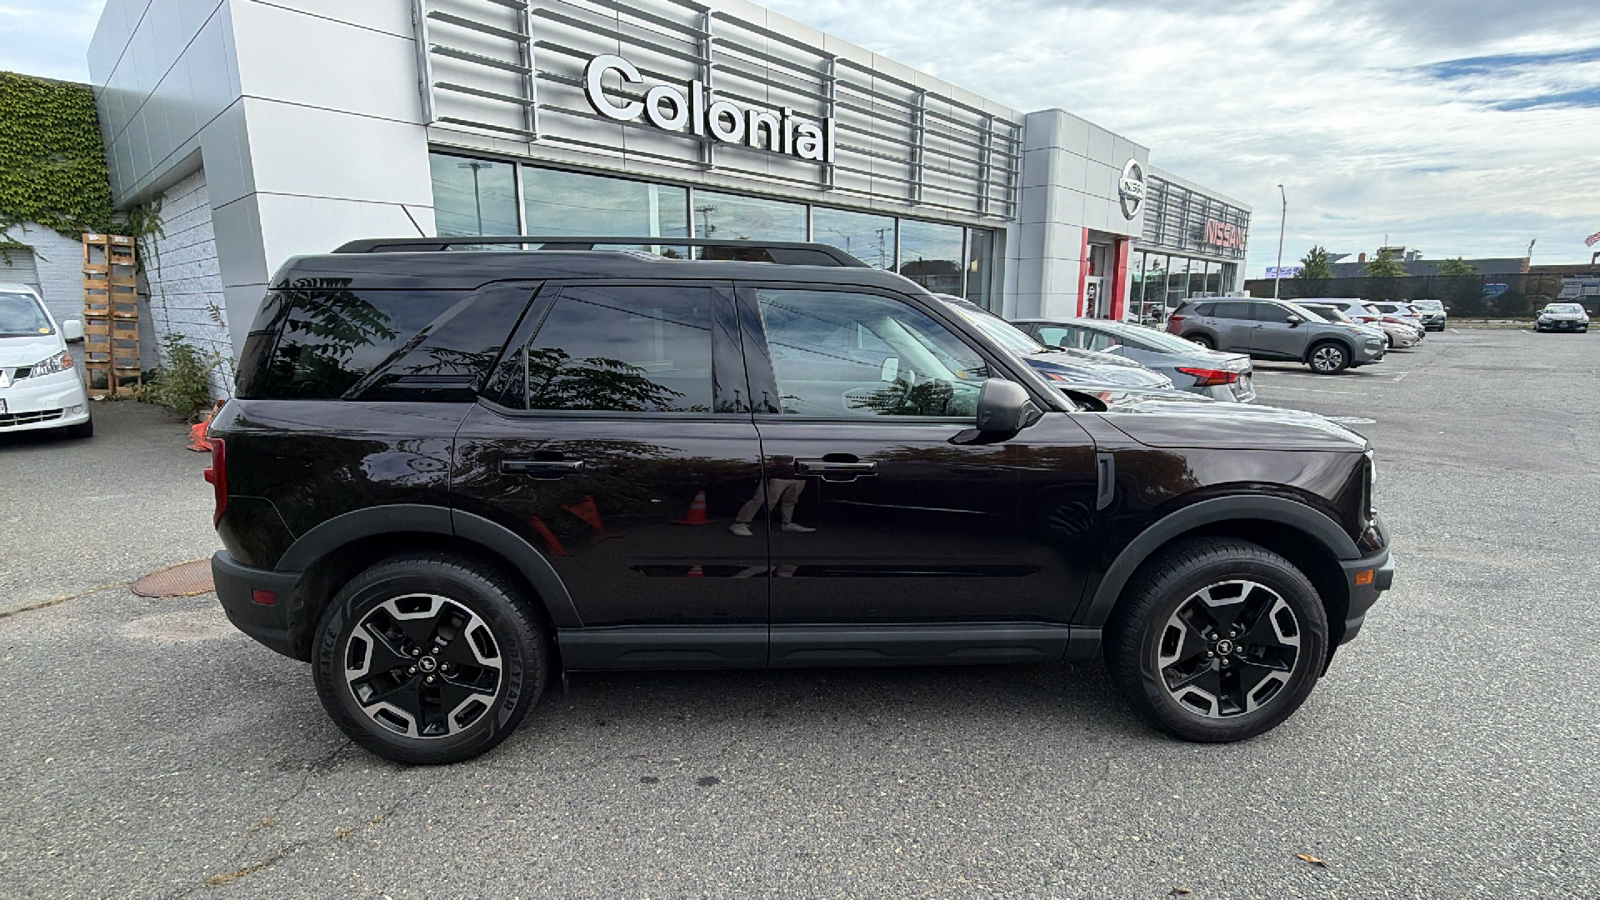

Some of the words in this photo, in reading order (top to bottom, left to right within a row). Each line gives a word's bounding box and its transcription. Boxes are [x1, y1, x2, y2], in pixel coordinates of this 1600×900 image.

[583, 53, 835, 163] Colonial
[1124, 181, 1143, 194] NISS
[1205, 218, 1245, 250] NISSAN
